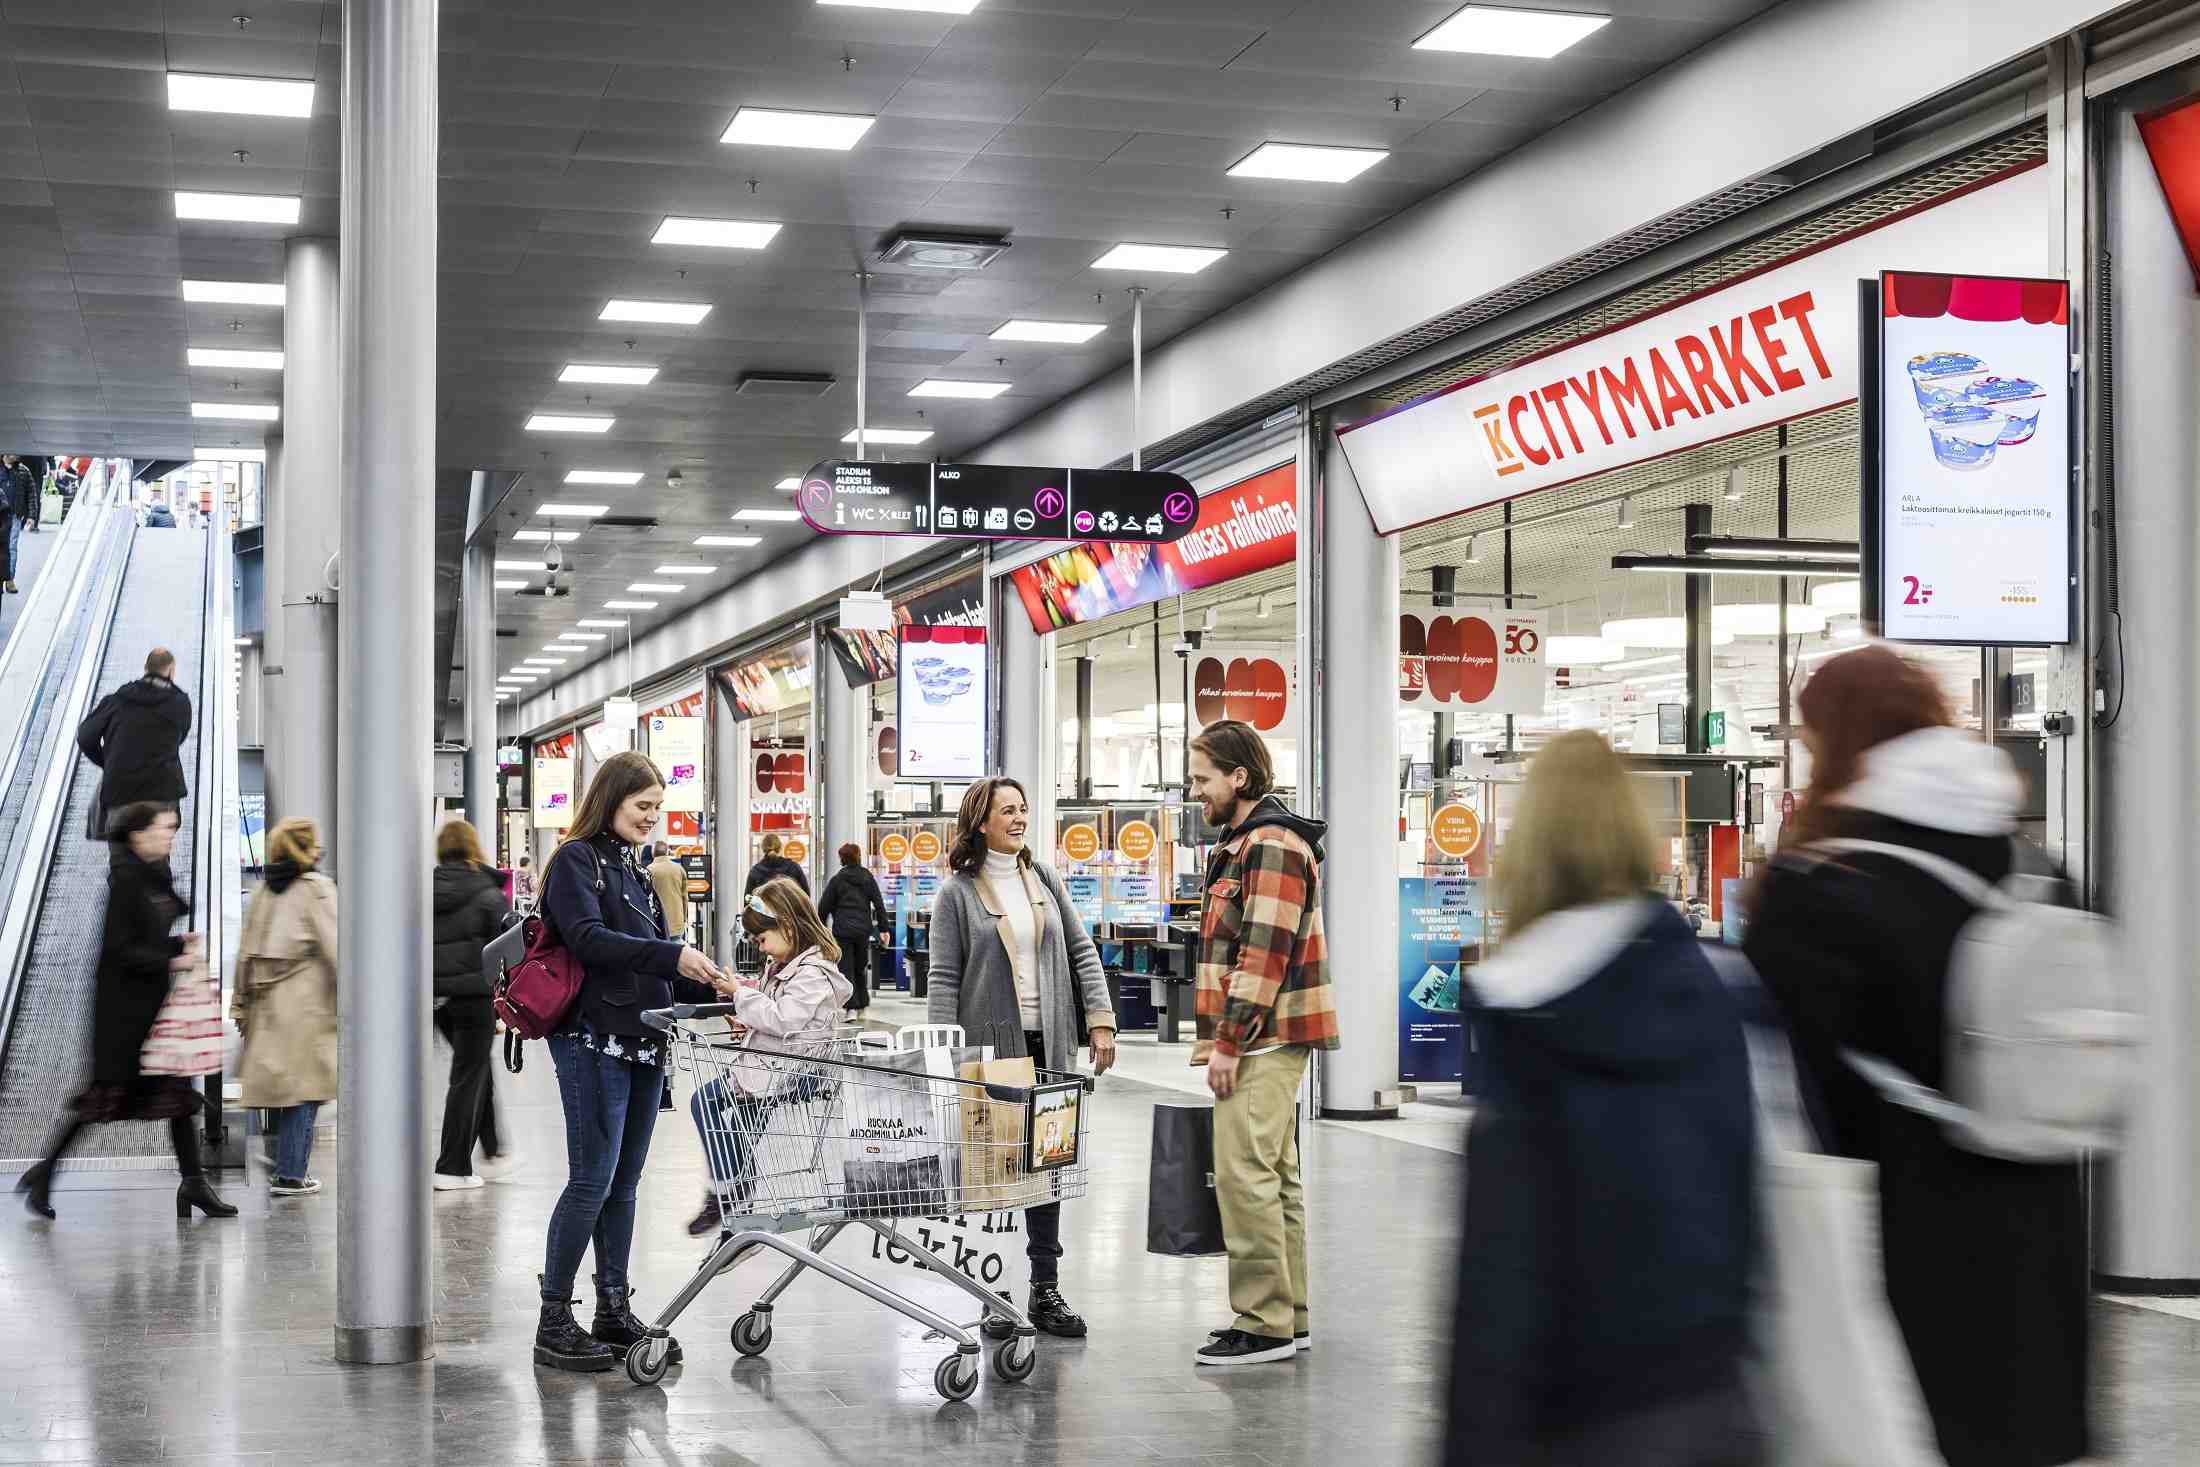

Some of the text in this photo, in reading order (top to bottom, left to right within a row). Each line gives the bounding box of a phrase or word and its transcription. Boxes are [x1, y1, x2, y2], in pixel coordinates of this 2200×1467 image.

[1508, 291, 1832, 466] CITYMARKET
[836, 467, 871, 476] STADIUM
[852, 507, 874, 520] WC
[1222, 495, 1296, 550] valikoima
[1504, 625, 1538, 655] 50
[2017, 683, 2031, 705] 18
[1712, 719, 1724, 738] 16
